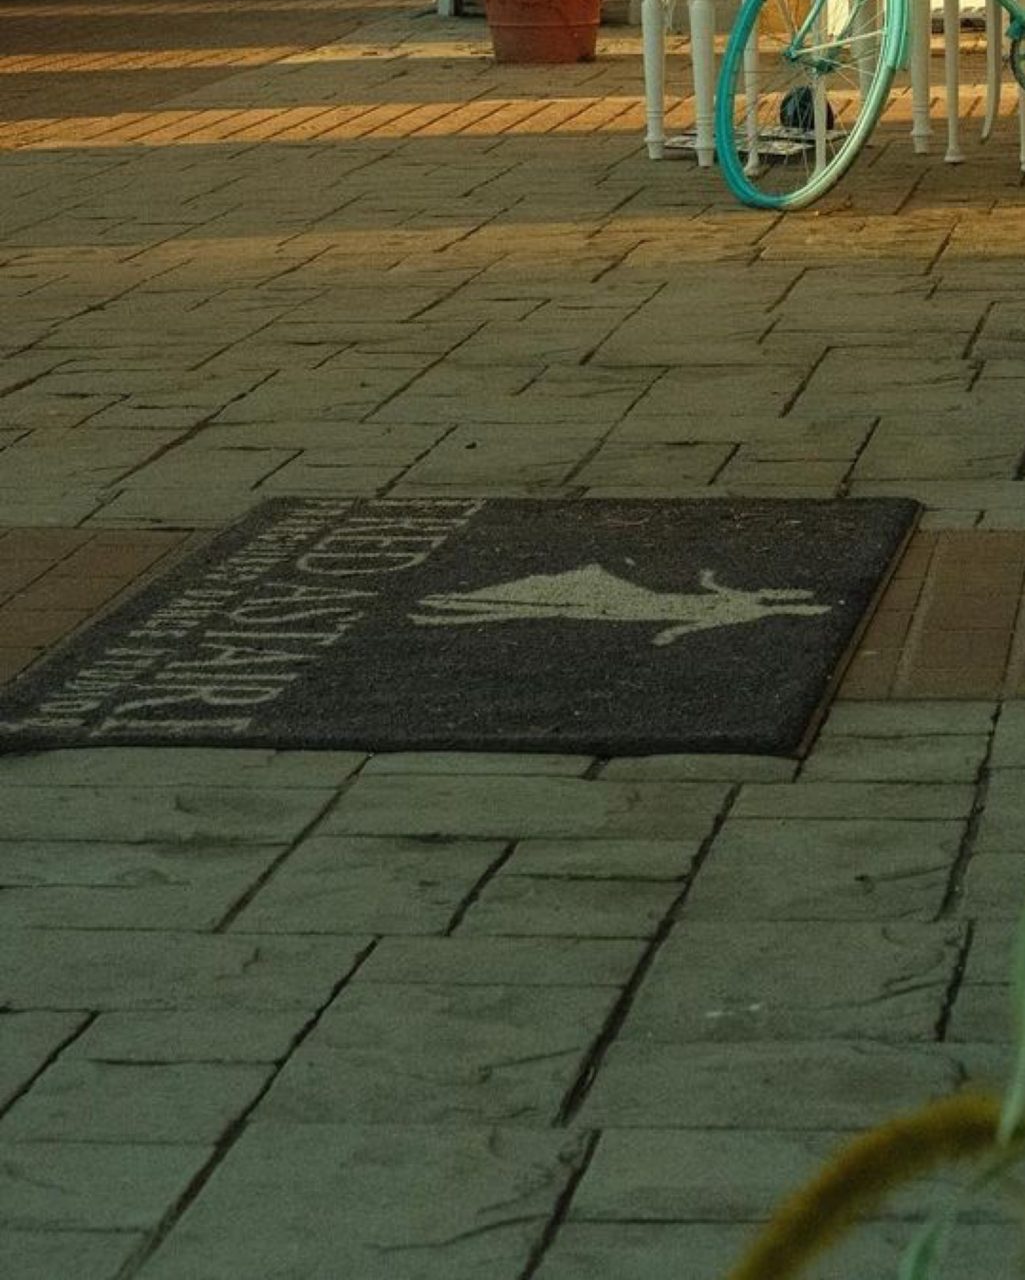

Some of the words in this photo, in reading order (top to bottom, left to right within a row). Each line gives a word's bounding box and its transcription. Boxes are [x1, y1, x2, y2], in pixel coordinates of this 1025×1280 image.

[298, 498, 488, 576] FRED
[128, 589, 241, 638] DANCE
[98, 581, 380, 734] ASTAIRE
